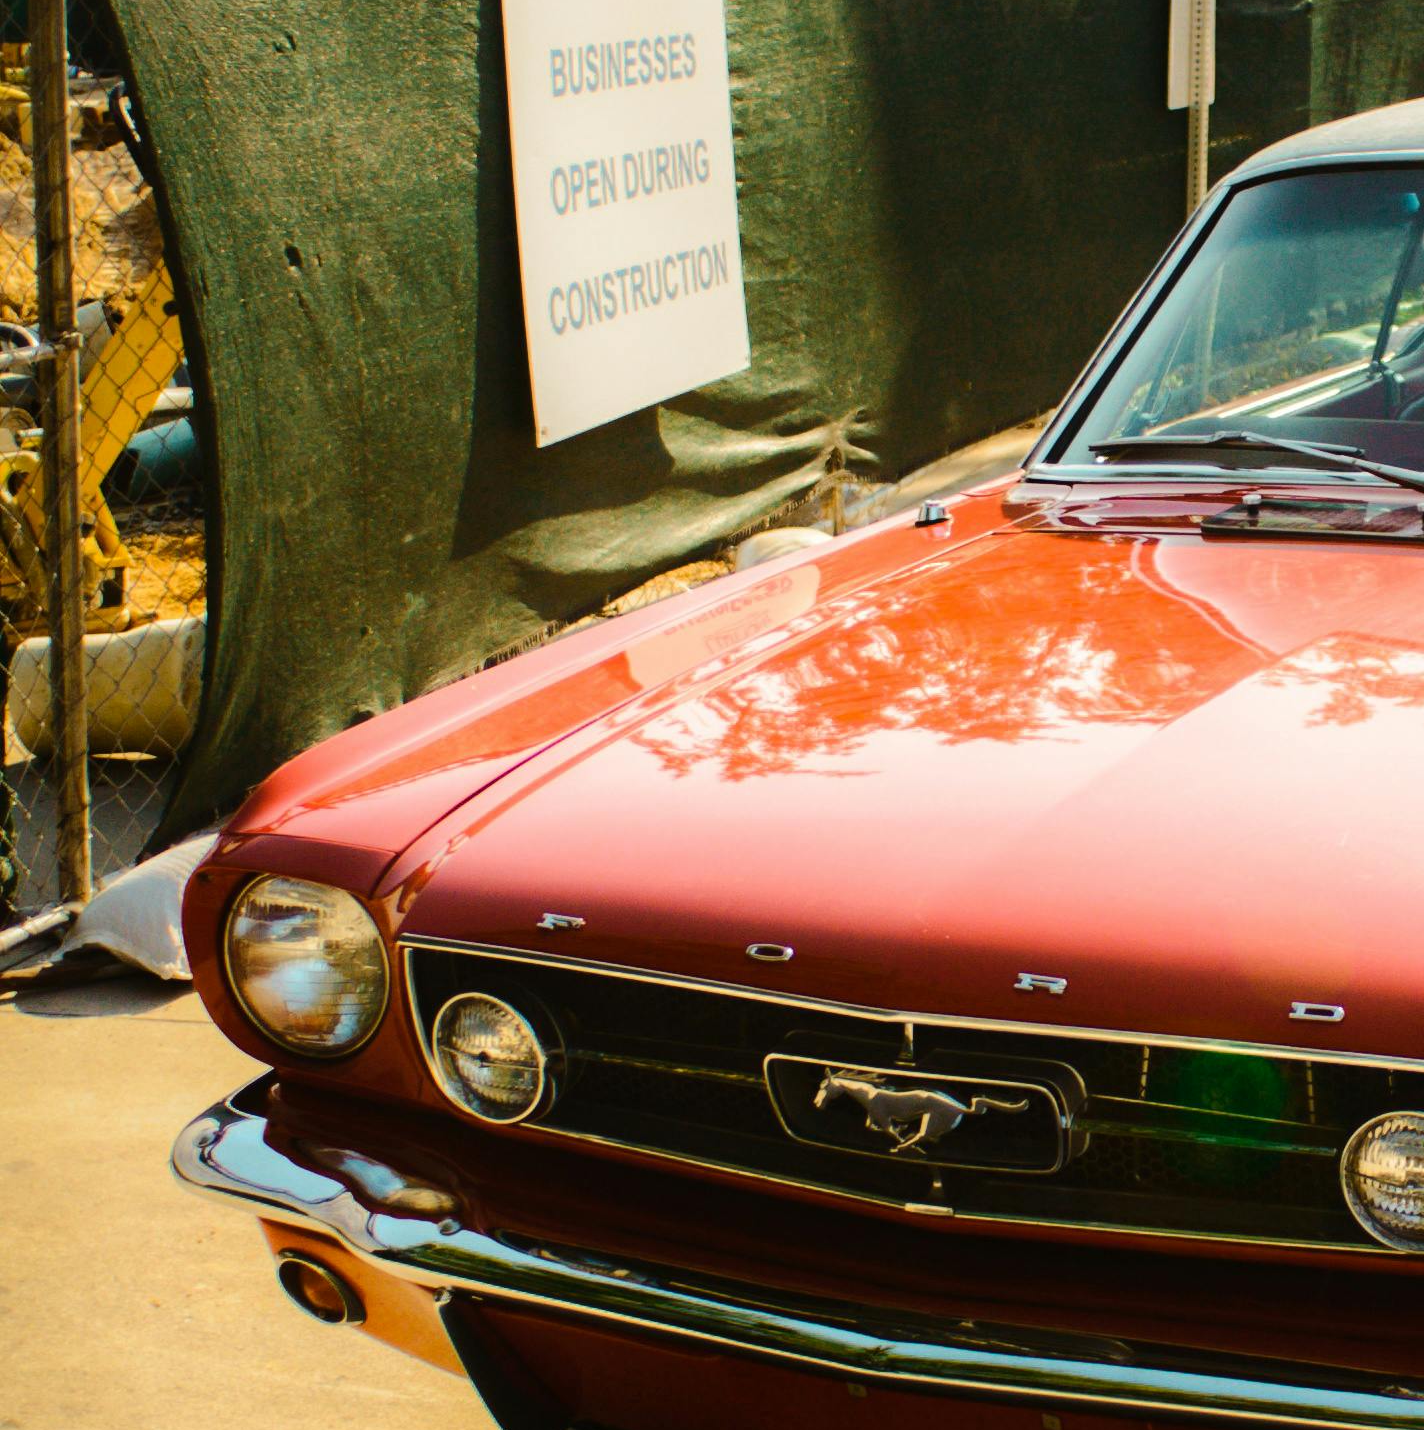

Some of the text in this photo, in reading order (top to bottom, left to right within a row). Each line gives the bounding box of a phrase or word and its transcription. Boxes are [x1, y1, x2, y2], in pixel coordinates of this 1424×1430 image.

[550, 33, 697, 97] BUSINESSES
[551, 138, 711, 216] OPEN DURING
[549, 240, 729, 335] CONSTRUCTION
[535, 911, 1346, 1024] FORD
